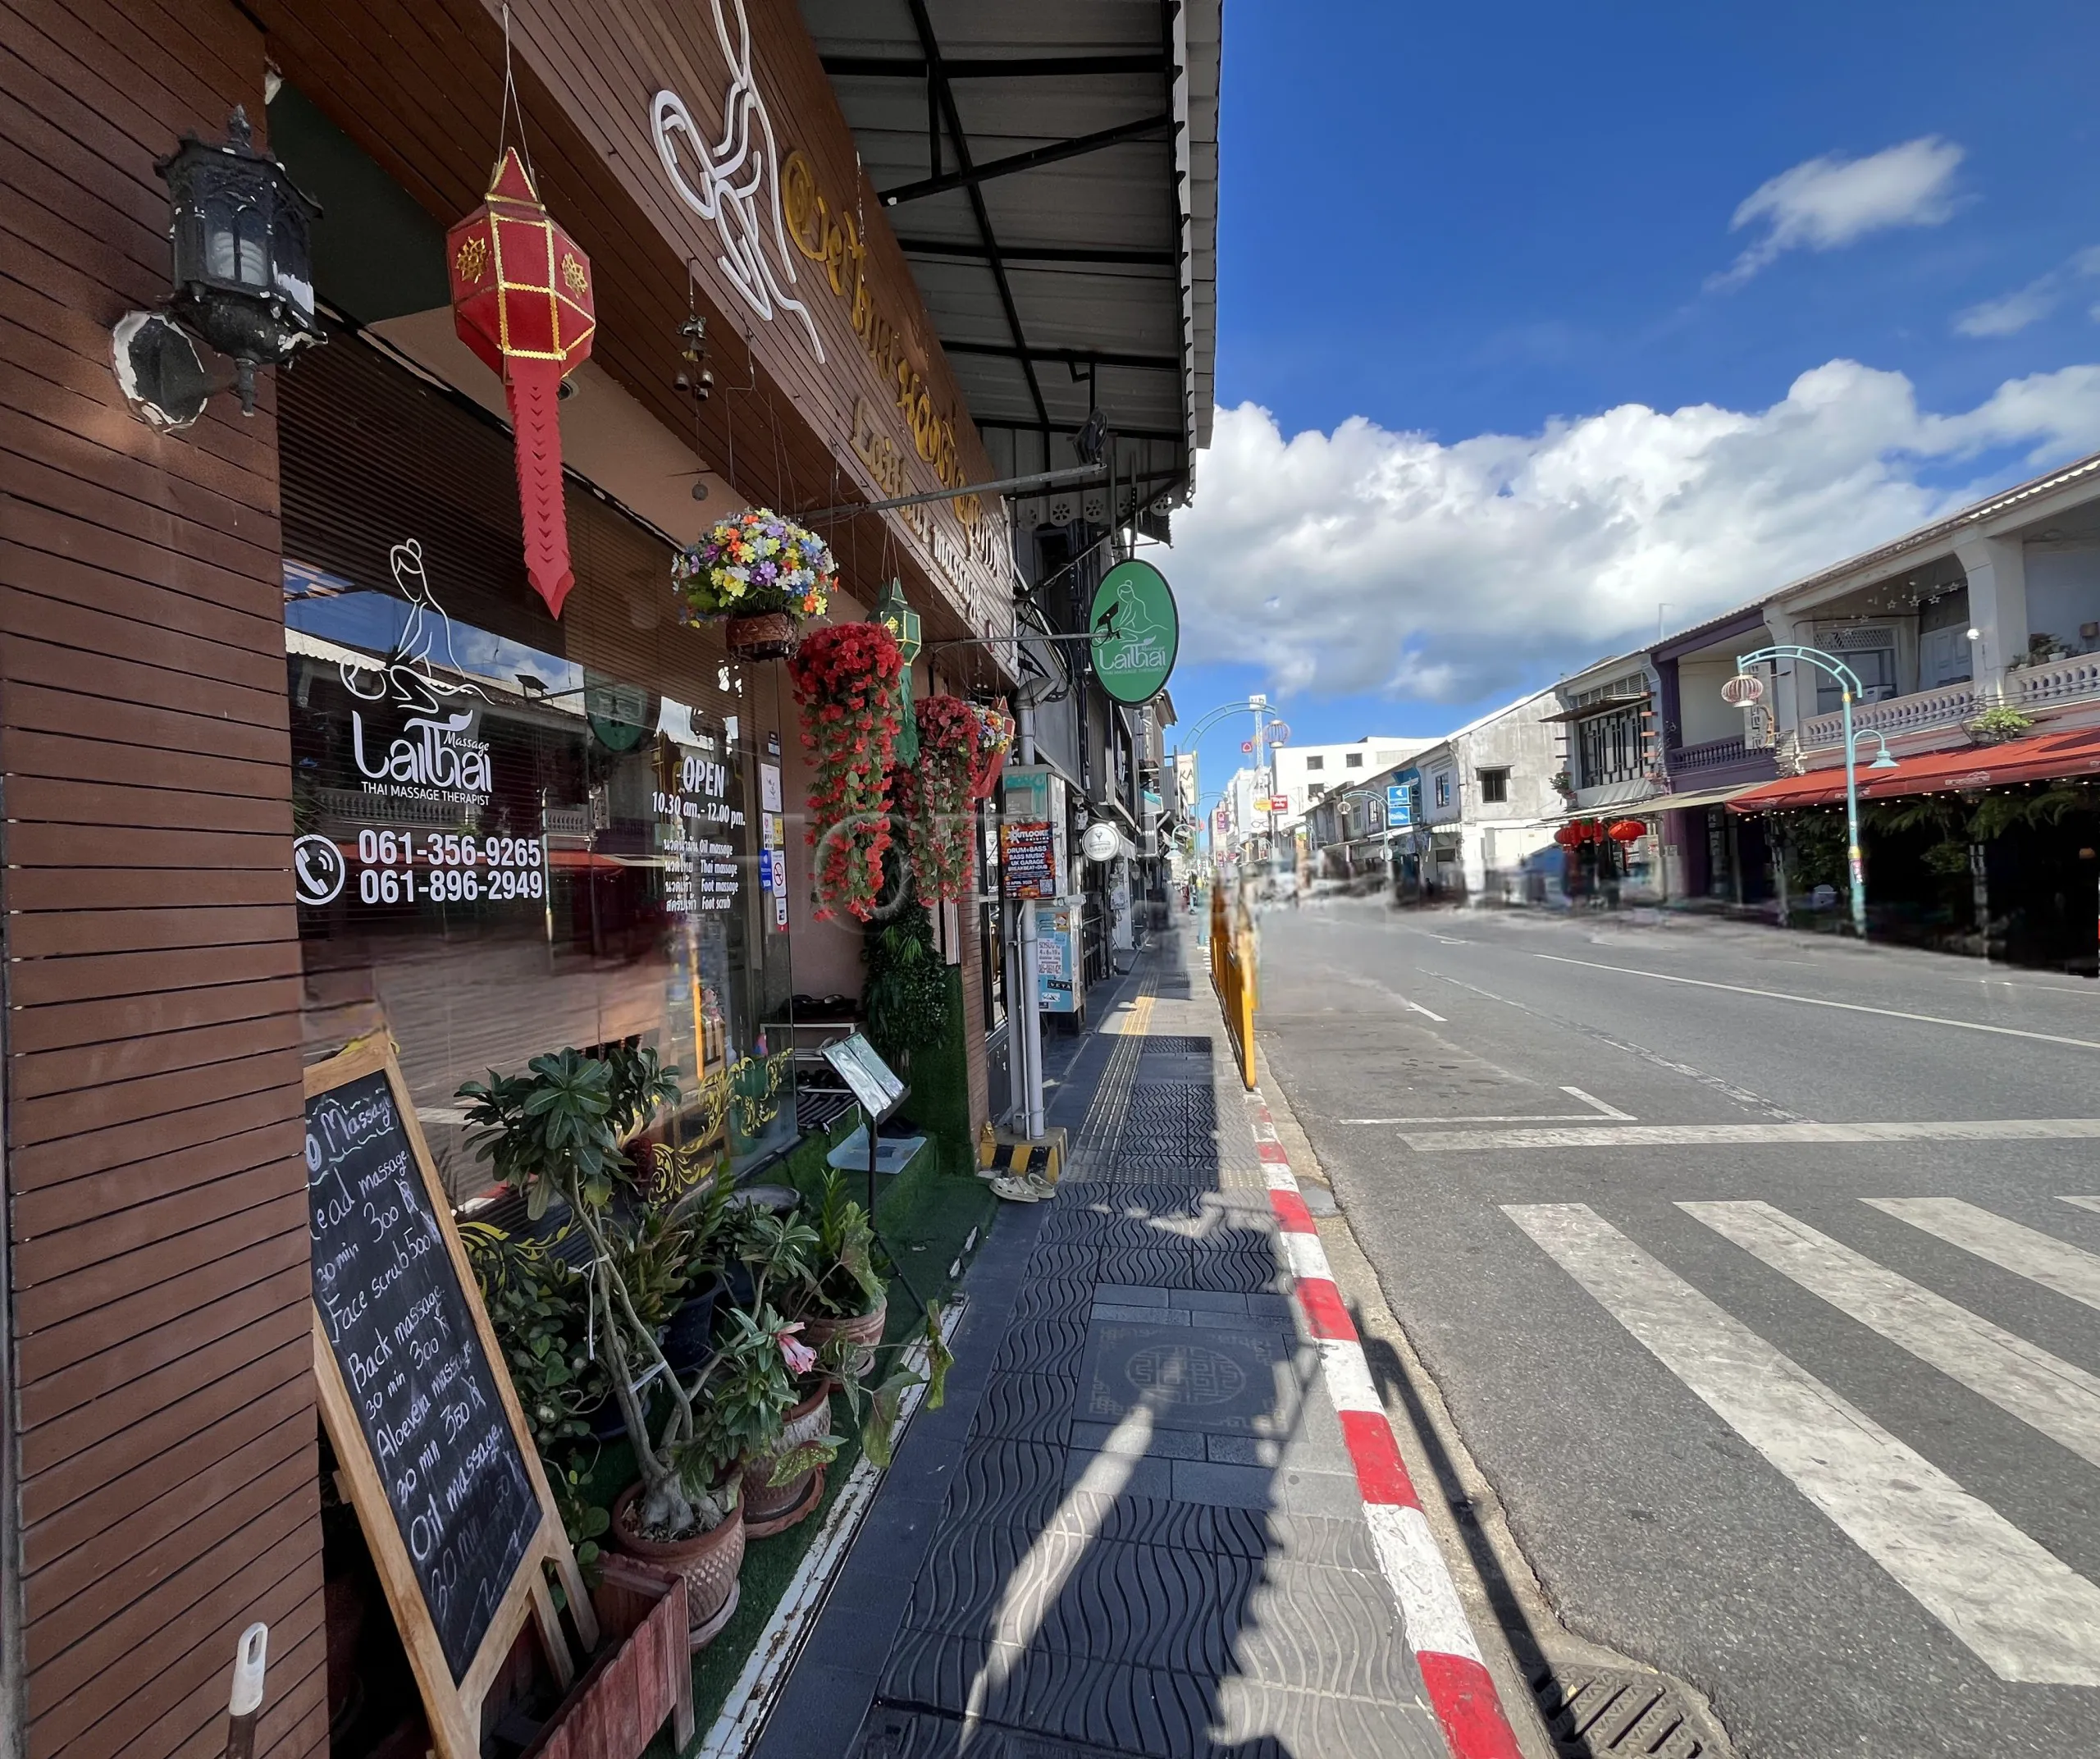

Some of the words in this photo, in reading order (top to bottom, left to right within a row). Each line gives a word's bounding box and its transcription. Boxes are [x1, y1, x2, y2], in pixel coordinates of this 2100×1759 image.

[932, 527, 982, 624] massage
[444, 731, 490, 756] Massage
[361, 781, 387, 796] THAI
[390, 785, 440, 802] MASSAGE
[441, 791, 490, 806] THERAPIST
[682, 755, 725, 798] OPEN
[652, 791, 681, 816] 10.30
[707, 802, 729, 824] 12.00
[730, 810, 746, 829] pm.
[358, 829, 542, 867] 061-356-9265
[699, 839, 708, 853] Oil
[709, 843, 733, 857] massage
[360, 869, 543, 904] 061-896-2949
[701, 859, 714, 874] Thai
[714, 863, 737, 878] massage
[701, 878, 714, 893] Foot
[715, 881, 738, 896] massage
[701, 896, 714, 910] Foot
[716, 895, 731, 909] scrub
[336, 1241, 360, 1269] min
[363, 1201, 399, 1243] 300
[321, 1291, 368, 1344] Face
[372, 1240, 410, 1299] scrub
[403, 1227, 431, 1259] 500
[348, 1327, 393, 1393] Back
[366, 1391, 383, 1420] 30
[387, 1370, 407, 1397] min
[409, 1337, 440, 1370] 300
[397, 1468, 417, 1506] 30
[419, 1440, 441, 1479] min
[440, 1401, 470, 1445] 350
[410, 1494, 444, 1560] Oil
